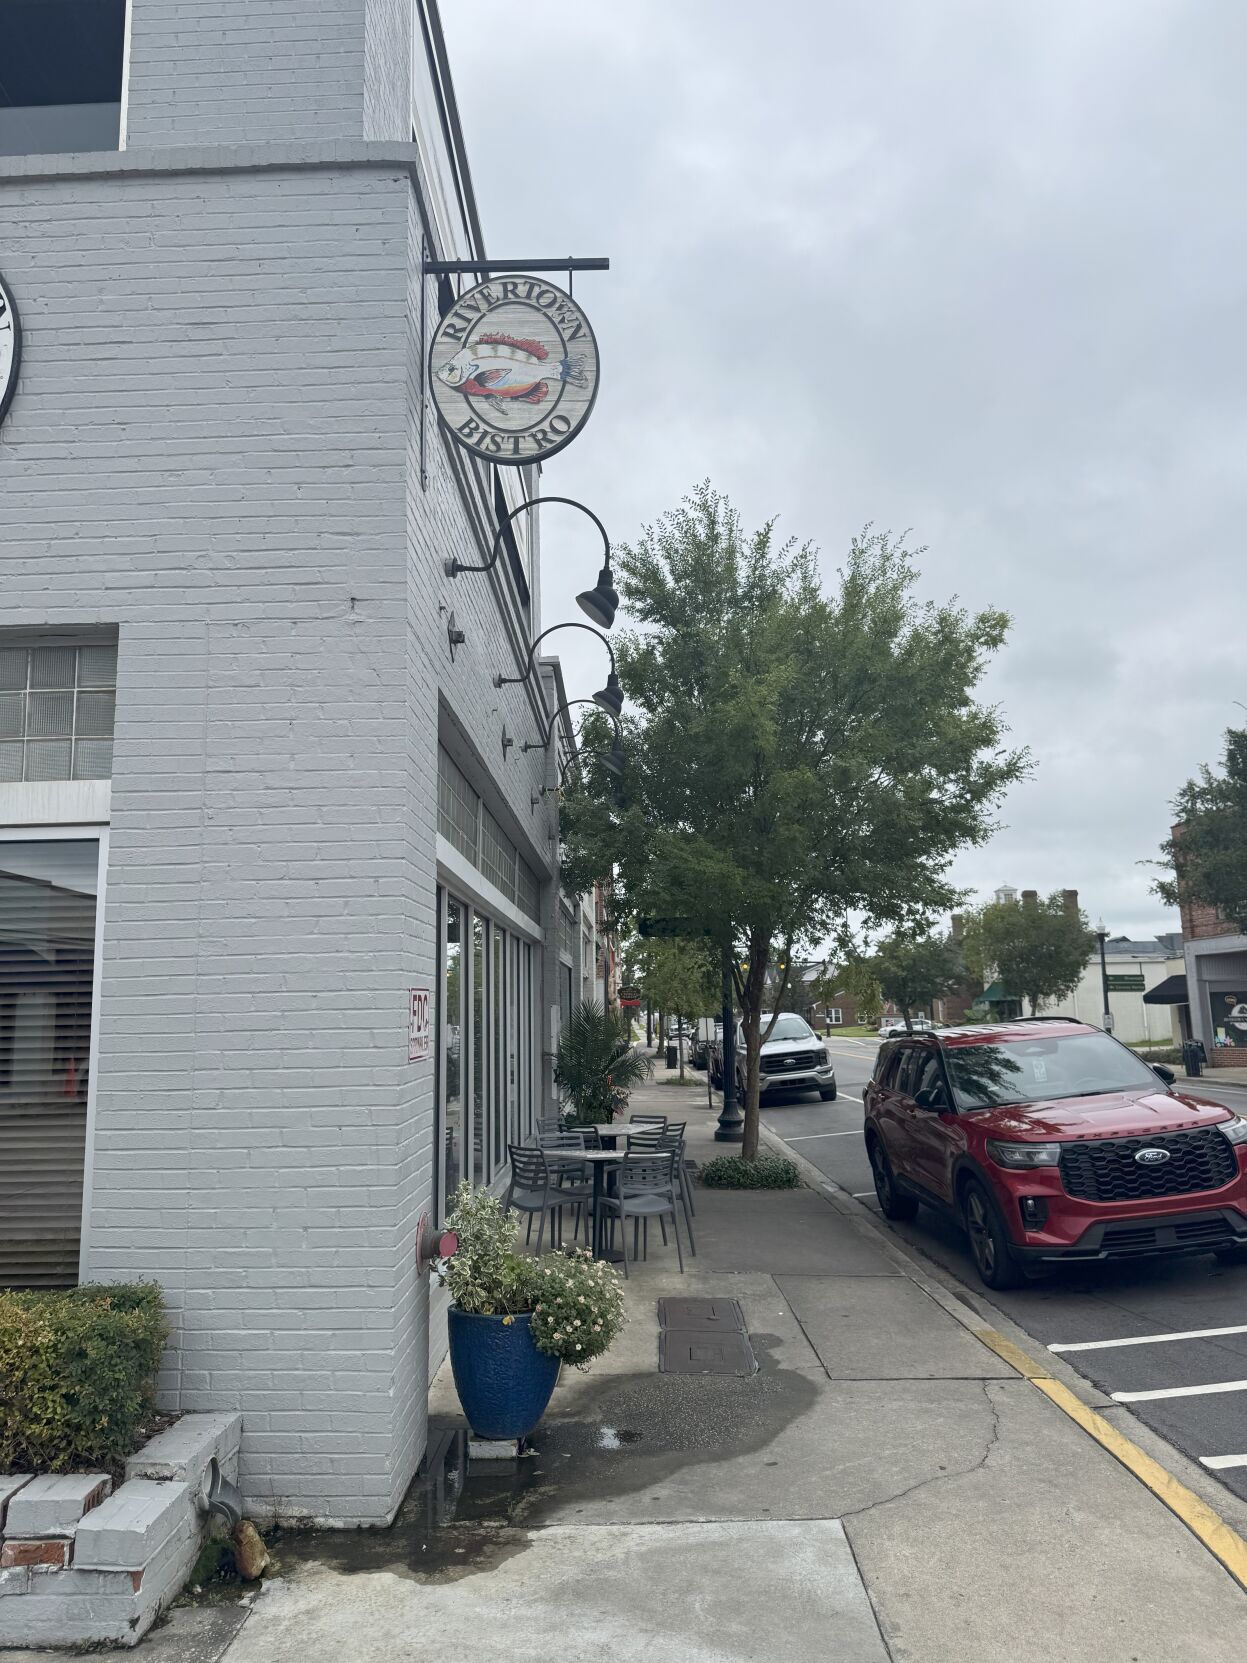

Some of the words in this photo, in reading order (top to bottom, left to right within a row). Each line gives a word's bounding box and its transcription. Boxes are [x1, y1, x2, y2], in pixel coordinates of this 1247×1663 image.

[441, 280, 587, 343] RIVERTOWN
[455, 414, 571, 455] BISTRO
[411, 994, 429, 1033] FDC
